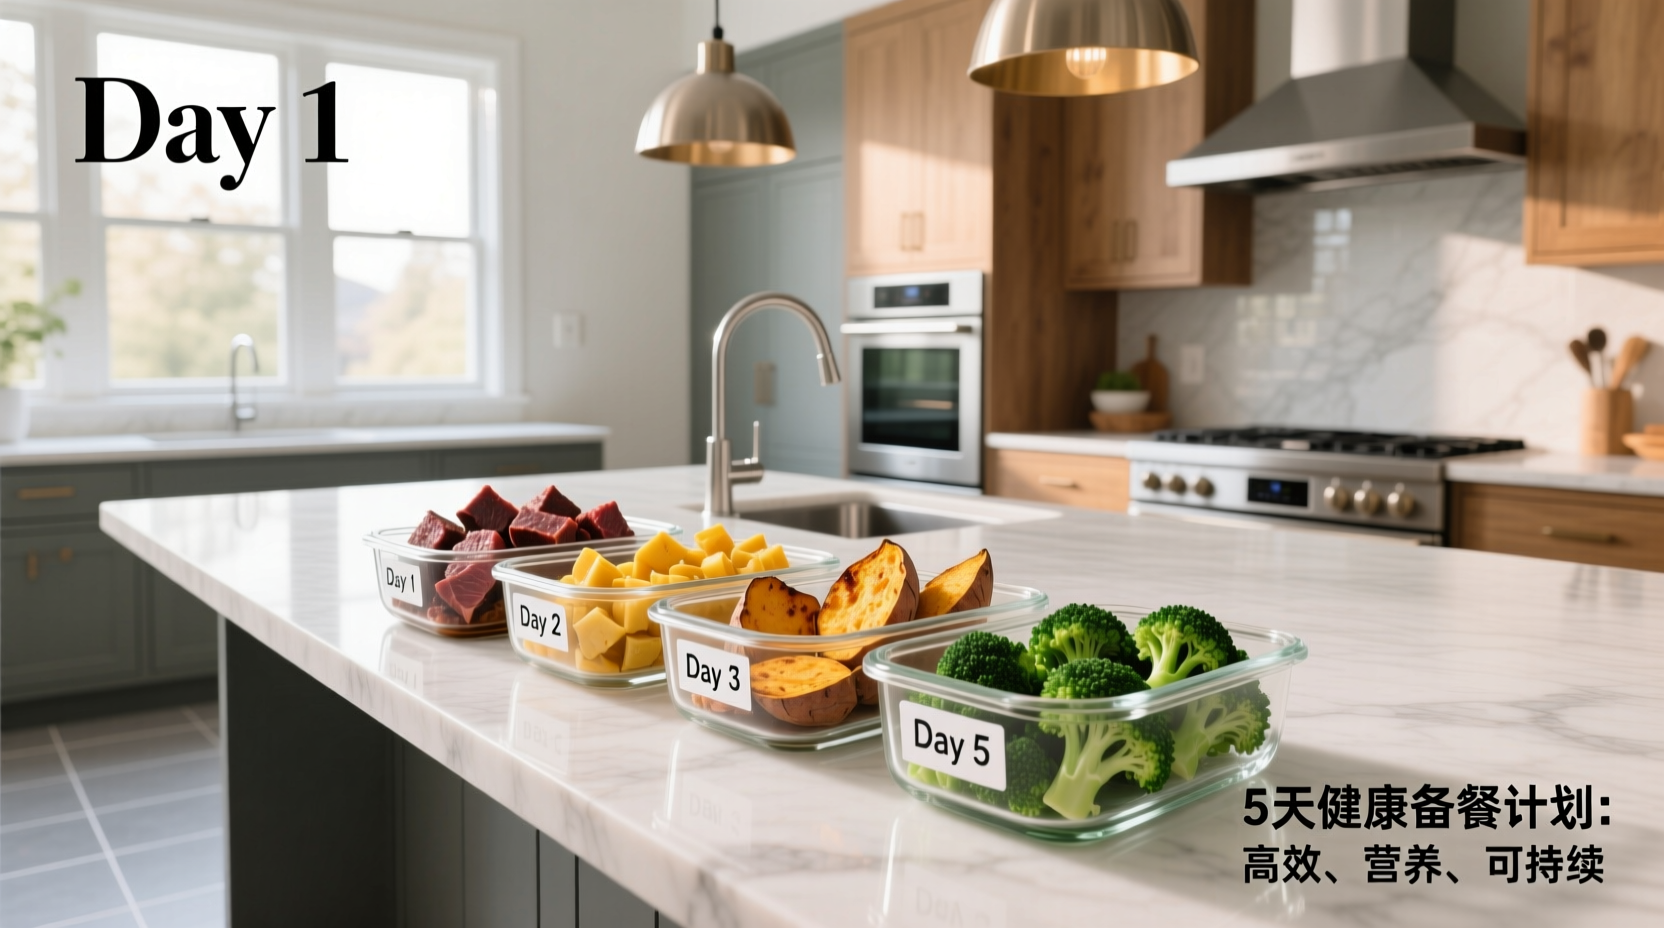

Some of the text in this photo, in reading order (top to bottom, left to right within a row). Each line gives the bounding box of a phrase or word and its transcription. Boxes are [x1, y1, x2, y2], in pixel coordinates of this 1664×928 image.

[387, 567, 415, 593] Day 1
[521, 605, 561, 637] Day 2
[687, 653, 740, 691] Day 3
[915, 719, 990, 766] Day 5
